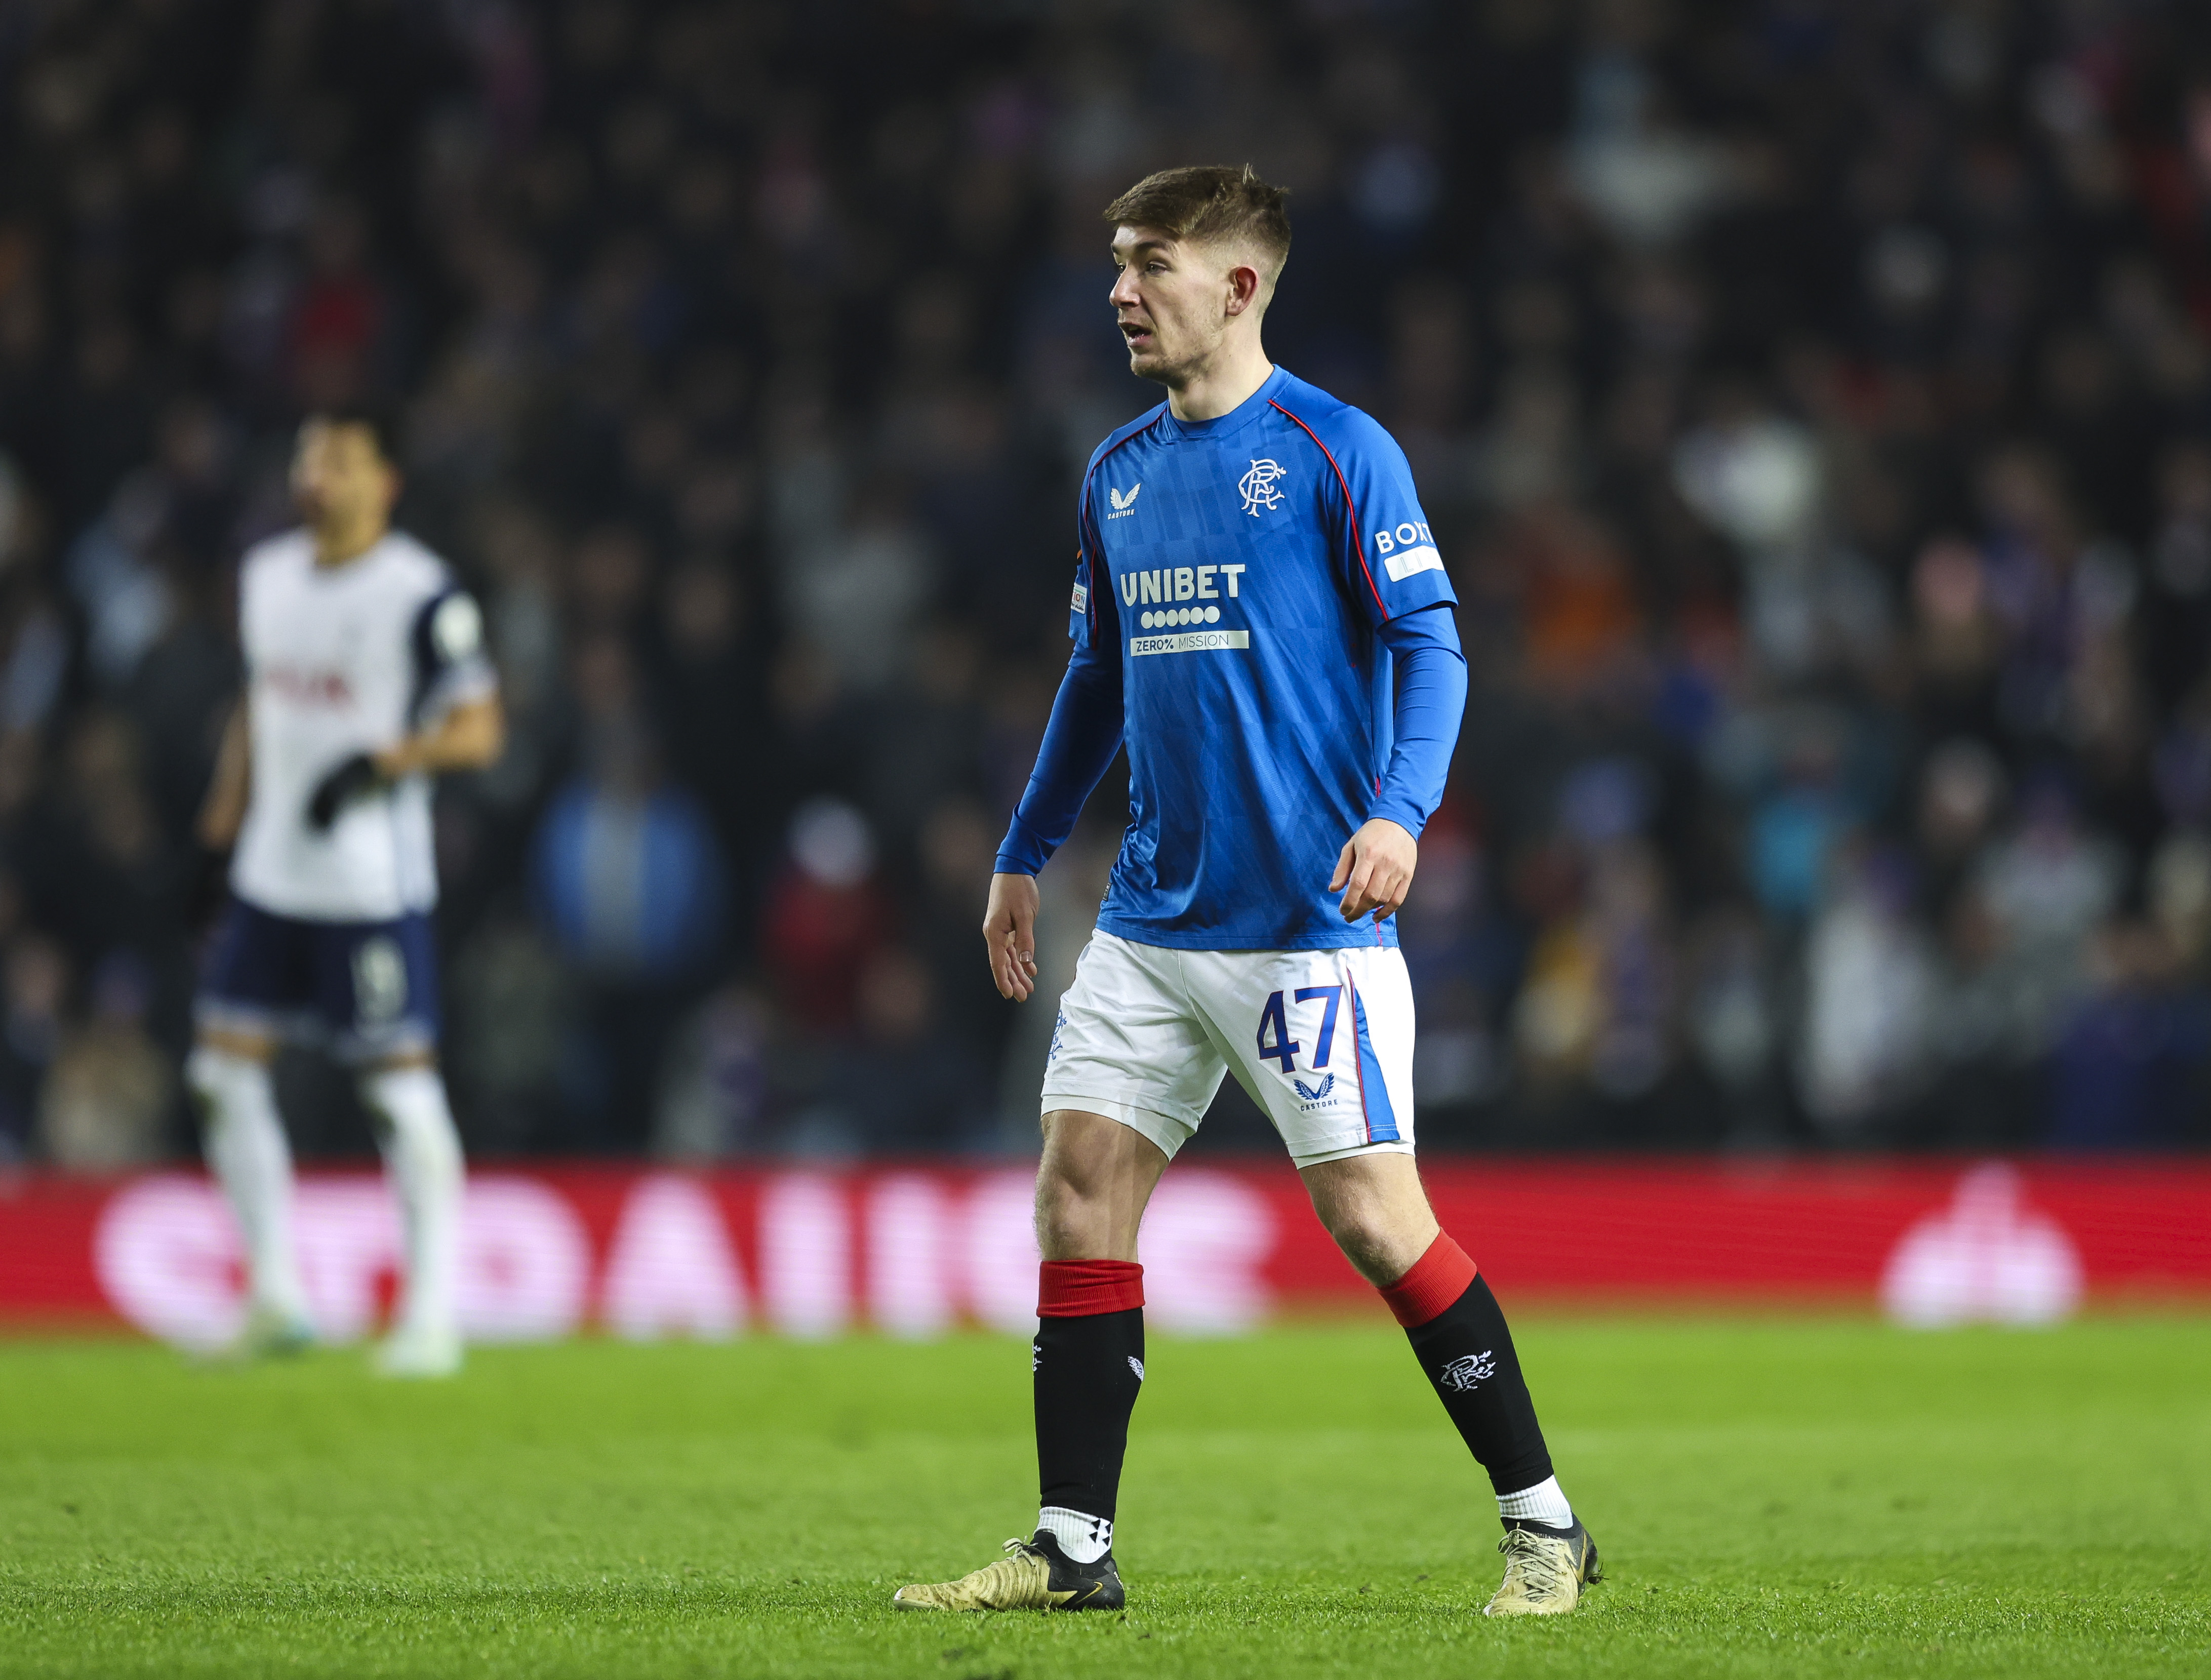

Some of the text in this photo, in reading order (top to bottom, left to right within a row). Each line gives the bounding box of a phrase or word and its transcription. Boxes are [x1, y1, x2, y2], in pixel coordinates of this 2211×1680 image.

[1108, 509, 1134, 520] CASTORE
[1120, 564, 1245, 607] UNIBET
[1136, 634, 1229, 652] ZERO% MISSION
[1257, 985, 1343, 1074] 47
[1301, 1099, 1338, 1111] CASTORE
